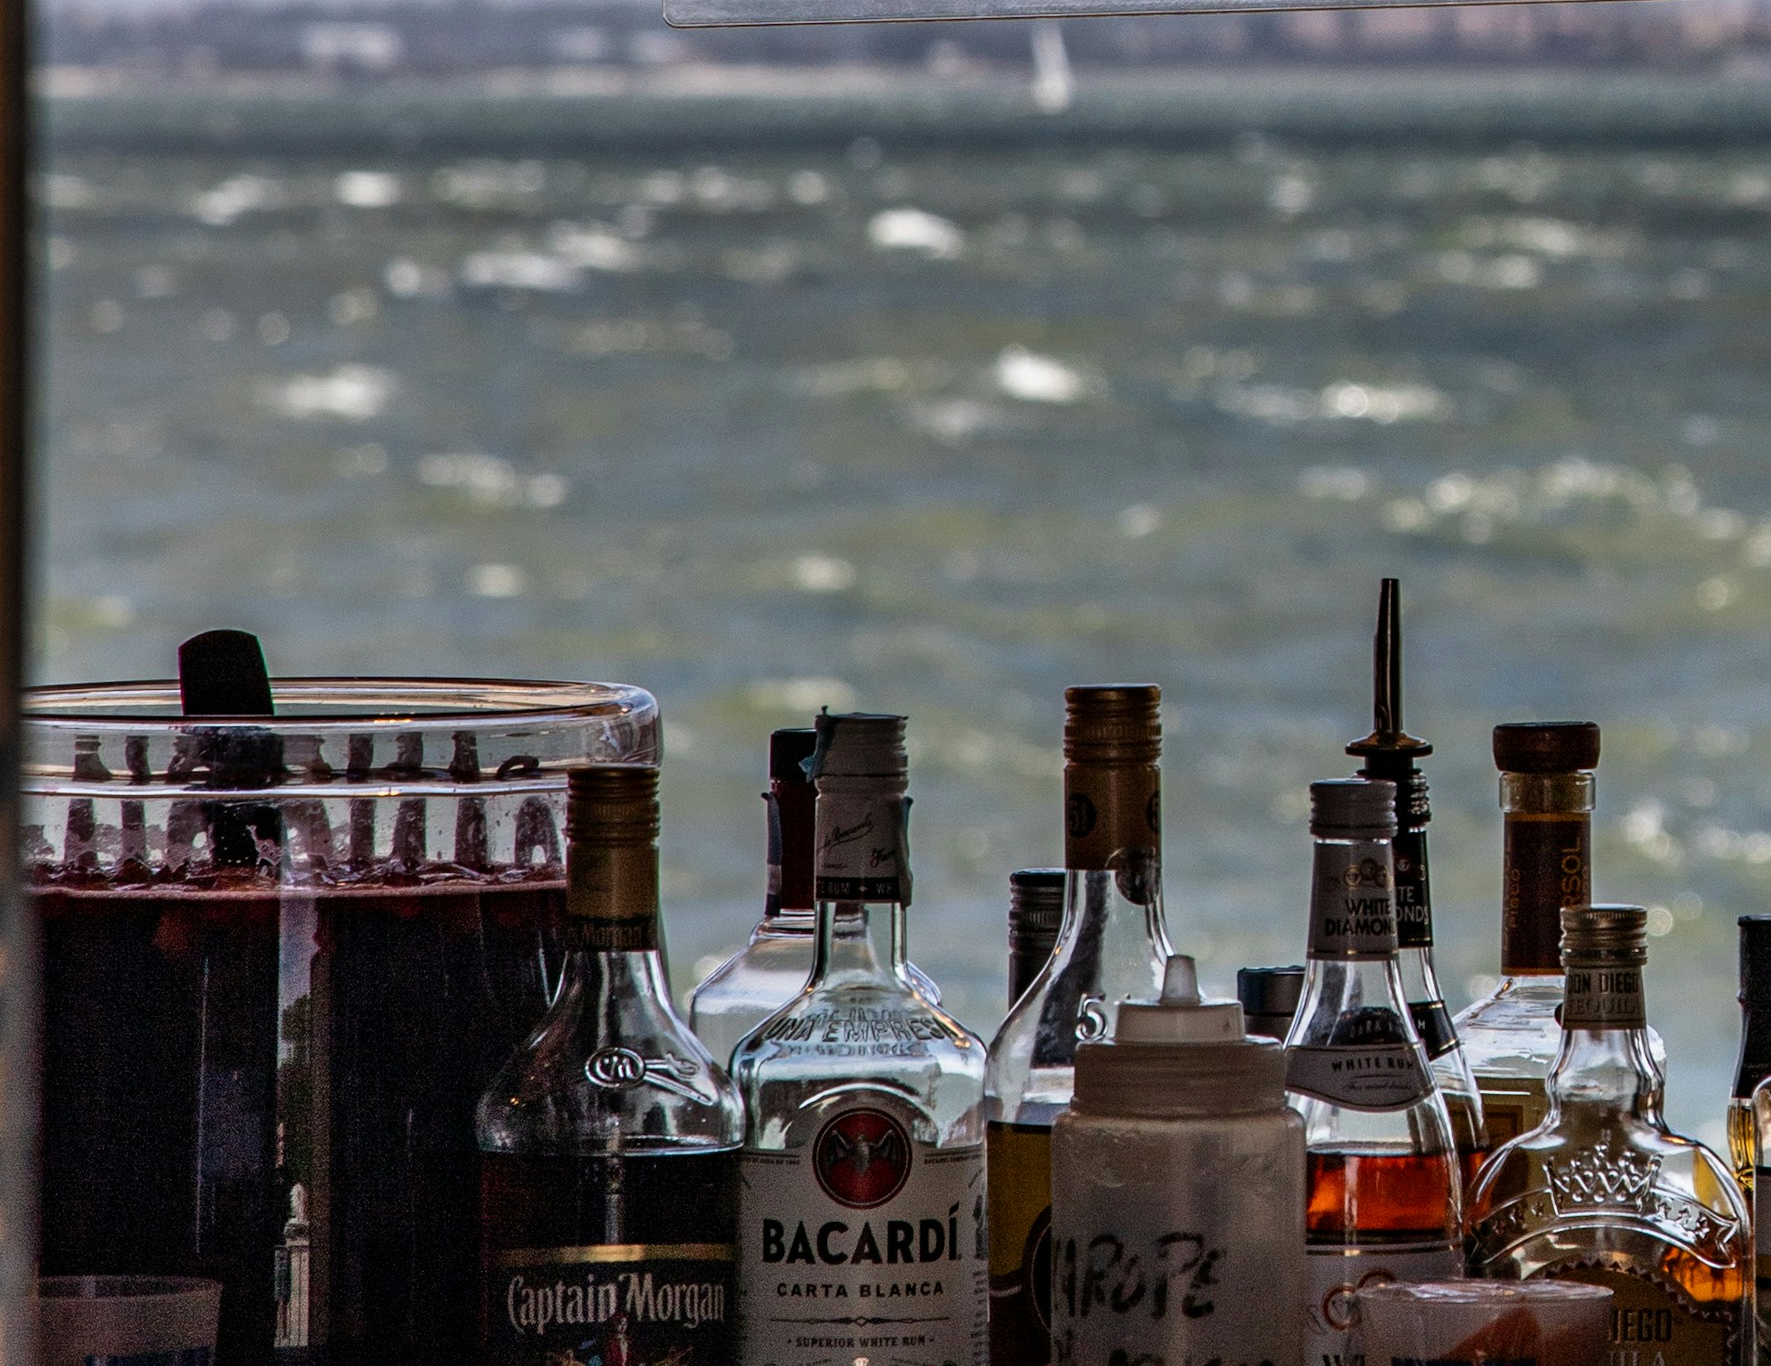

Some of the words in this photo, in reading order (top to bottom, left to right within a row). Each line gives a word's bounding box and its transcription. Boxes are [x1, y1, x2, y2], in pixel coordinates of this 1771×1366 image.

[1345, 898, 1392, 916] WHITE
[1325, 918, 1396, 937] DIAMON
[1599, 972, 1639, 994] DIEGO
[1331, 1057, 1381, 1072] WHITE
[1388, 1057, 1415, 1071] RUM
[762, 1201, 960, 1265] BACARDÍ
[776, 1282, 849, 1298] CARTA
[859, 1280, 944, 1298] BLANCA
[507, 1274, 620, 1335] Captain
[619, 1272, 726, 1329] Morgan
[1610, 1307, 1672, 1342] IEGO
[795, 1336, 855, 1349] SUPERIOR
[860, 1336, 898, 1348] WHITE
[902, 1334, 926, 1346] RUM
